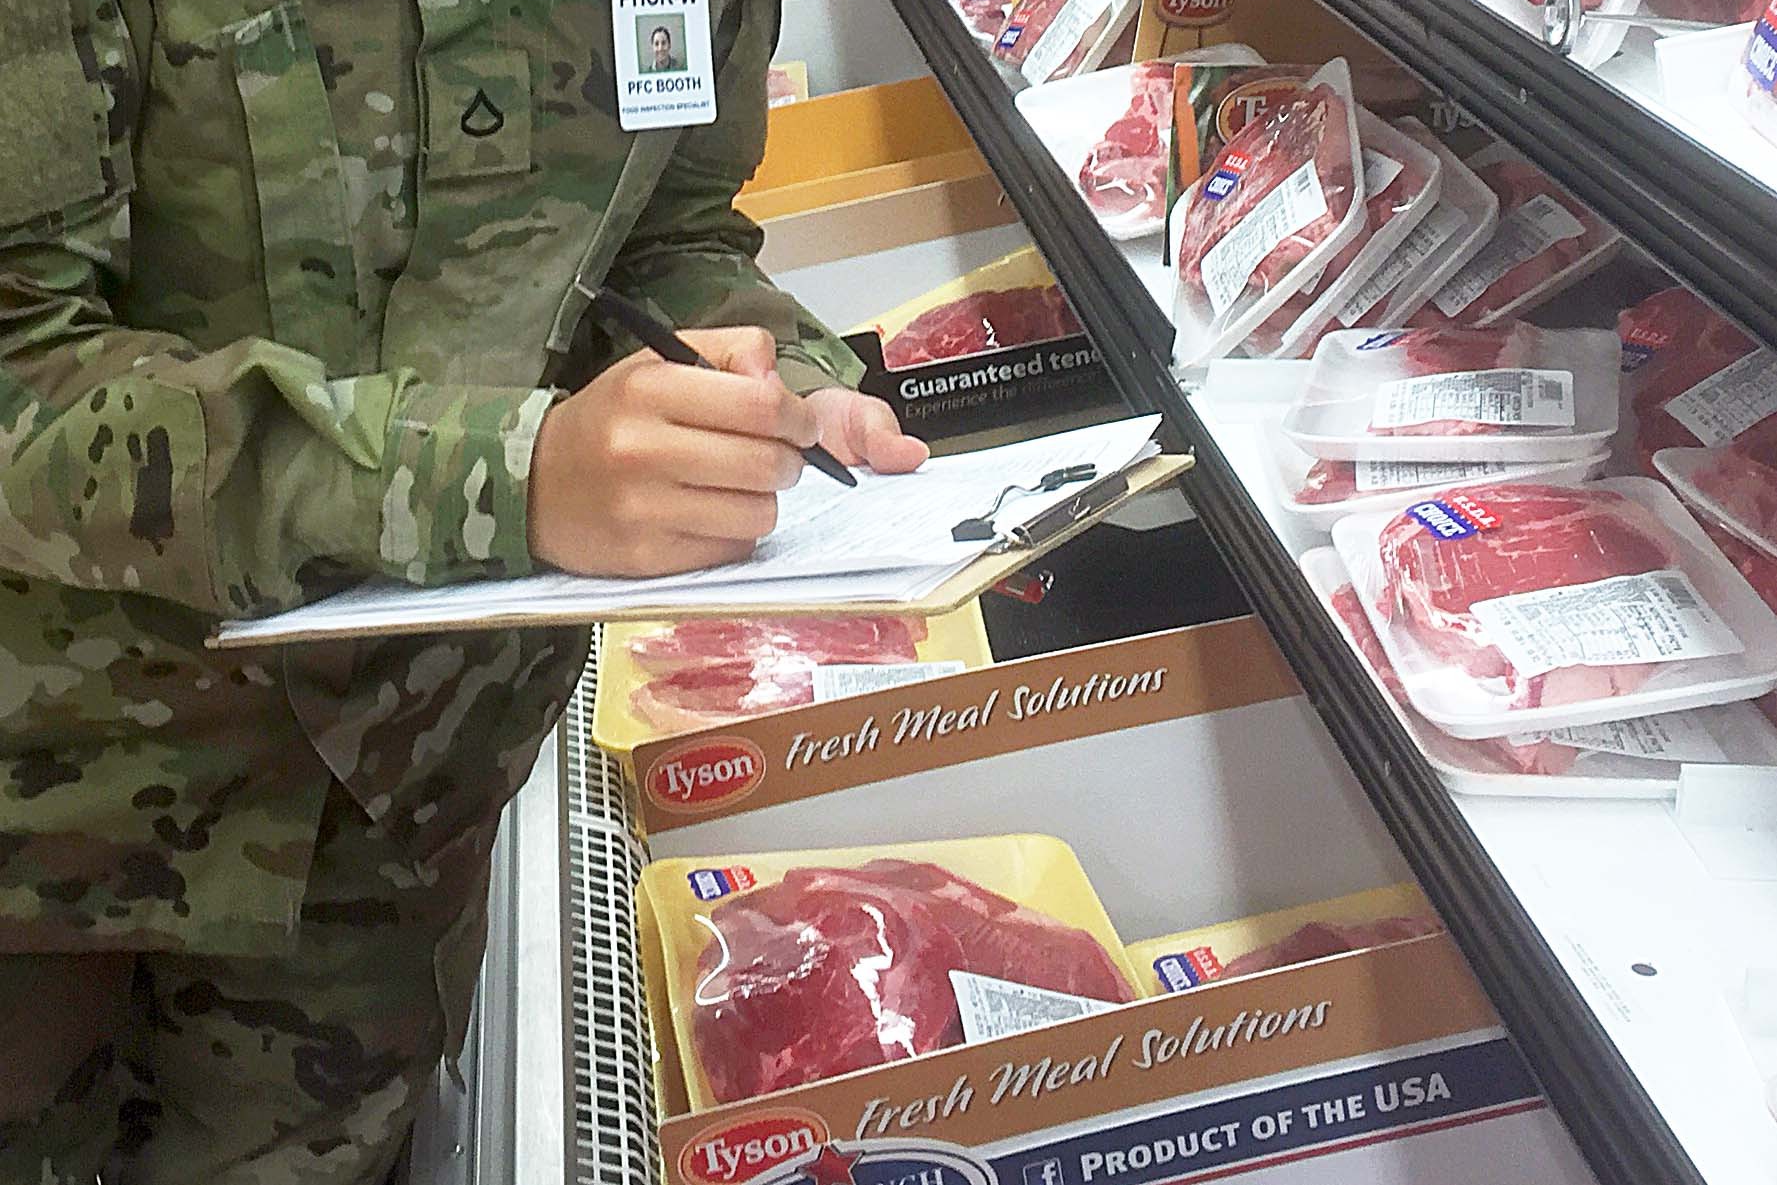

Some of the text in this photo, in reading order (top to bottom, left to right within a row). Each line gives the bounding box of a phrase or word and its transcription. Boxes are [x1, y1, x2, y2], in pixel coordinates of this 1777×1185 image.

[627, 76, 702, 95] PFC BOOTH
[899, 353, 1043, 400] Guaranteed
[905, 393, 989, 419] Experience
[992, 386, 1017, 401] the
[658, 753, 755, 800] Tyson
[785, 716, 881, 771] Fresh
[891, 687, 1001, 745] Meal
[1006, 667, 1168, 721] Solutions
[694, 1127, 818, 1180] Tyson
[854, 1073, 975, 1140] Fresh
[988, 1035, 1124, 1105] Meal
[1131, 999, 1333, 1070] Solutions
[1080, 1122, 1240, 1183] PRODUCT
[1251, 1109, 1294, 1141] OF
[1300, 1093, 1367, 1129] THE
[1373, 1072, 1452, 1115] USA
